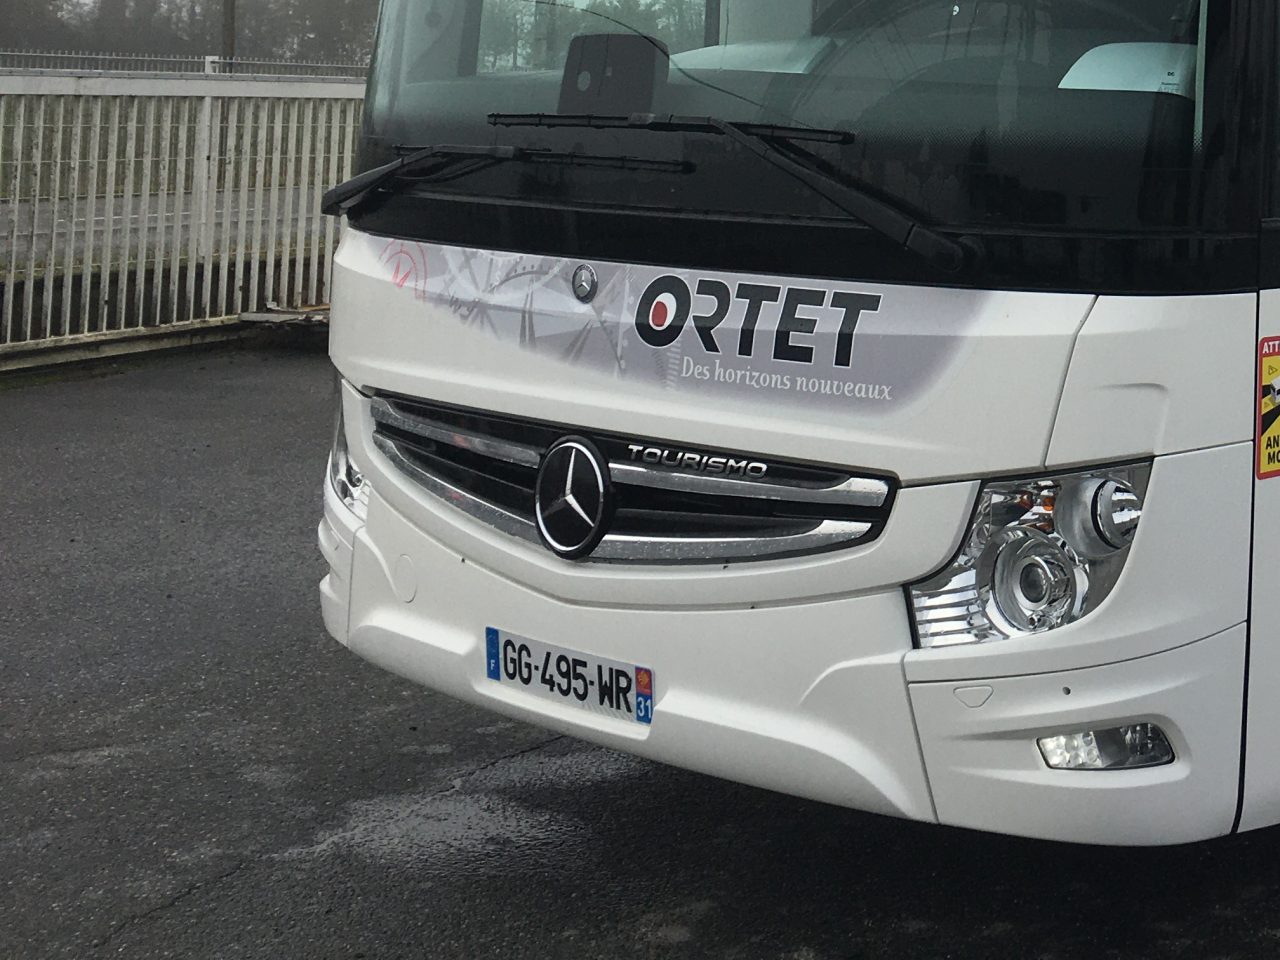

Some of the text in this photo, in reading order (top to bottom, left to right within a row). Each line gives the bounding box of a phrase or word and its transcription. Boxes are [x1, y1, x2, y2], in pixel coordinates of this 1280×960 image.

[635, 275, 882, 368] ORTET
[680, 356, 893, 400] Des horizons nouveaux
[627, 444, 768, 479] TOURISMO
[490, 659, 496, 671] F
[503, 639, 633, 713] GG-495-WR
[637, 697, 652, 719] 31
